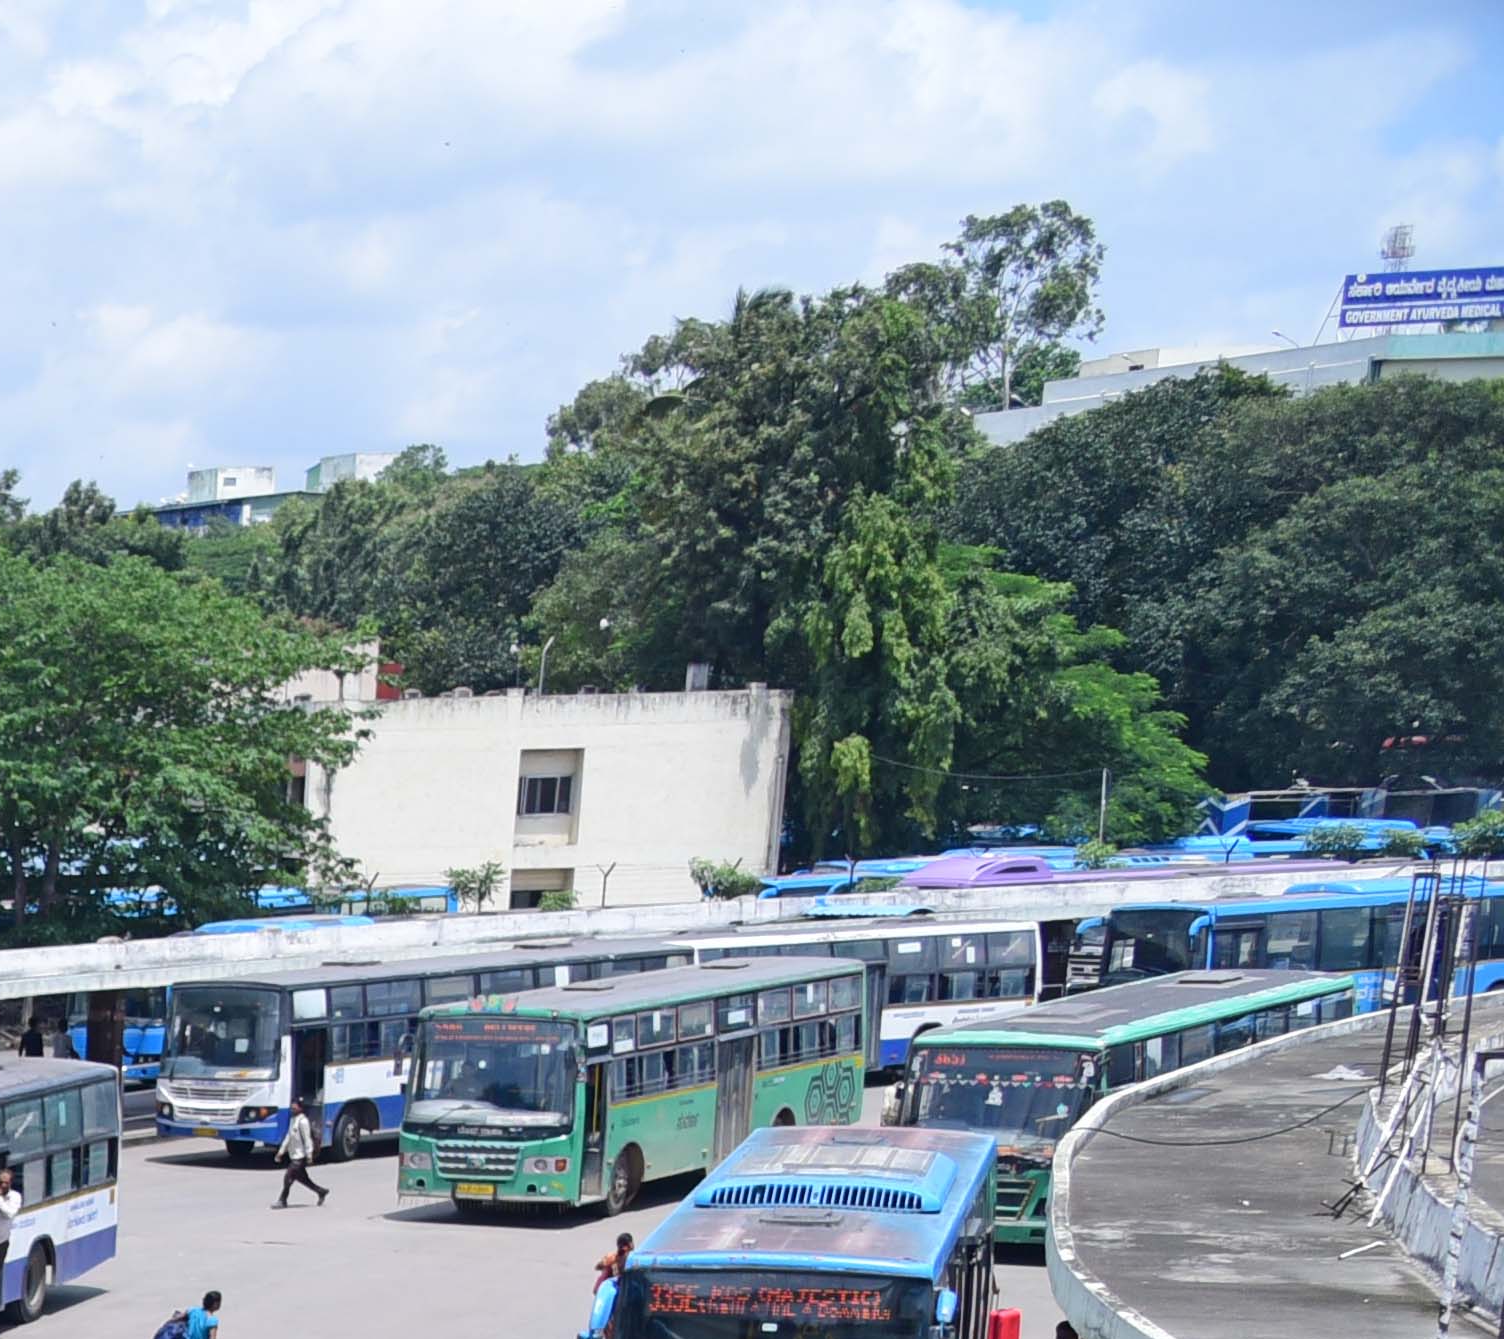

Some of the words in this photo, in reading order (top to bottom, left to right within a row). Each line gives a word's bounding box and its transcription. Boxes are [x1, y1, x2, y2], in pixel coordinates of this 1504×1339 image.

[1345, 308, 1408, 324] GOVERNMENT
[1409, 306, 1459, 320] AYURVEDA
[1461, 304, 1501, 317] MEDICAL
